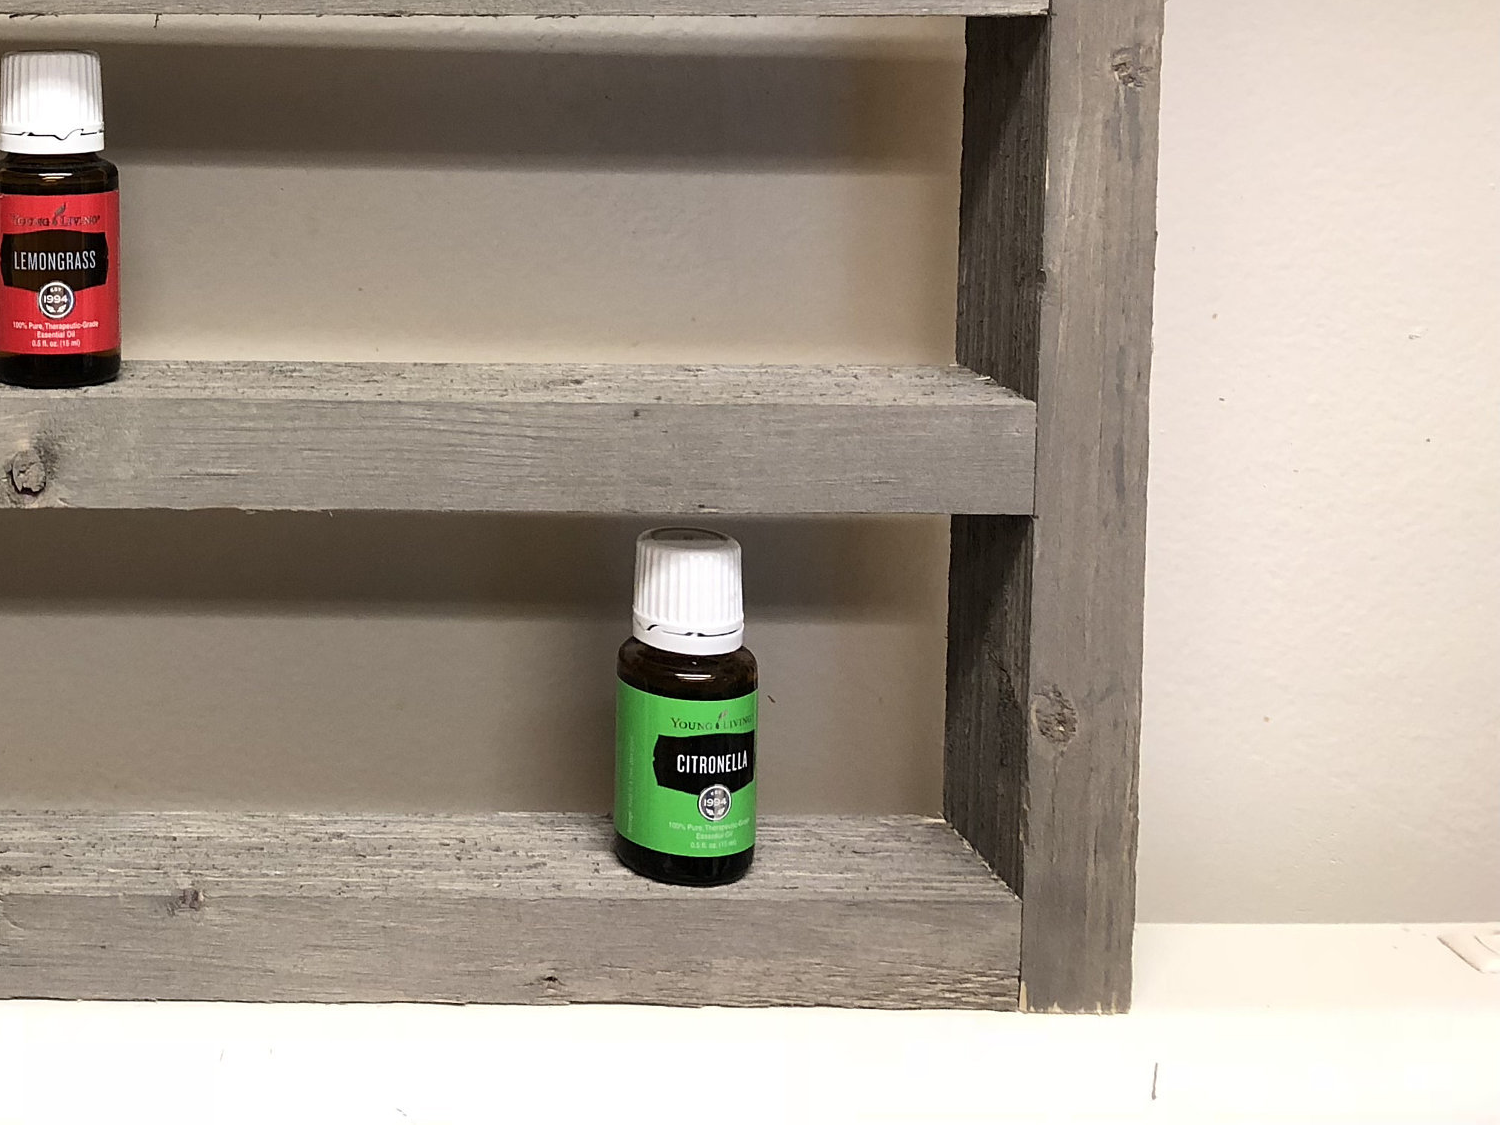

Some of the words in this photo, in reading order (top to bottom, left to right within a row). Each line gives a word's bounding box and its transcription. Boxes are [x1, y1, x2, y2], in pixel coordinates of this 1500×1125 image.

[14, 250, 96, 271] LEMONGRASS
[43, 294, 69, 304] 1994
[670, 717, 713, 731] YOUNG
[677, 750, 748, 774] CITRONELLA
[703, 797, 727, 807] 1994
